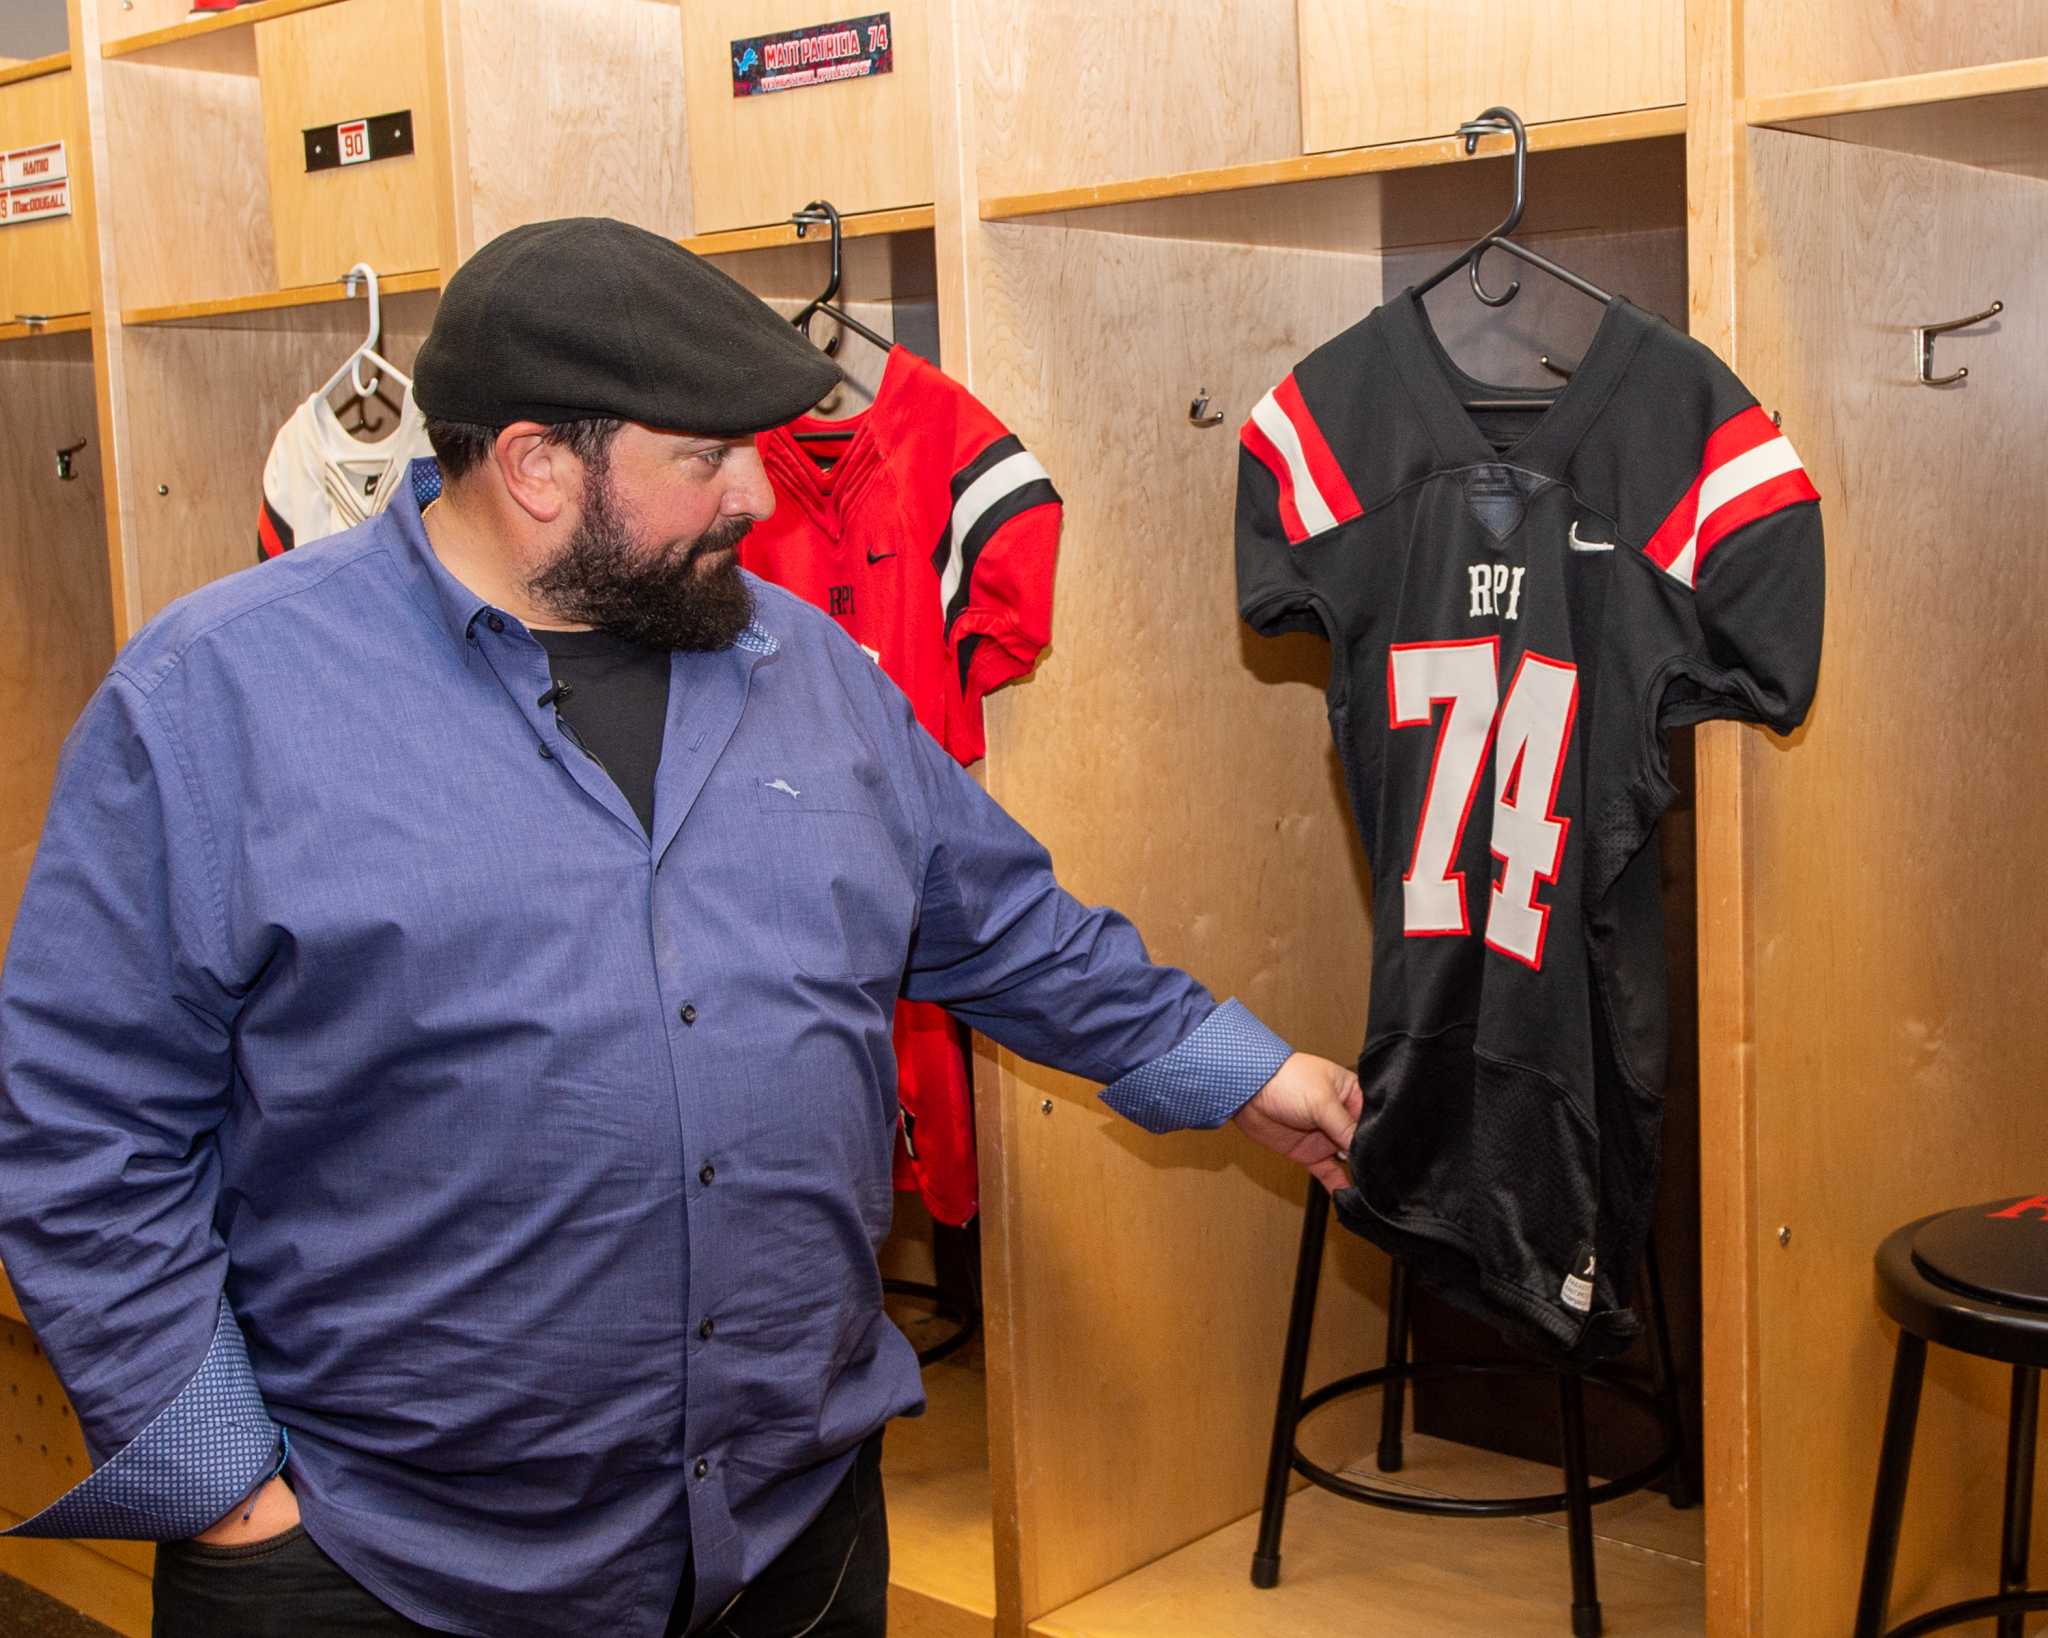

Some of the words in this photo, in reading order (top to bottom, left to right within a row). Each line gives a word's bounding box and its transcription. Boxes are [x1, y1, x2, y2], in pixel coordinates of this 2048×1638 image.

[764, 40, 800, 70] MATT
[800, 29, 861, 64] PATRICIA
[867, 24, 889, 53] 74
[344, 132, 364, 158] 90
[12, 192, 66, 215] MacDOUGALL
[828, 584, 856, 617] RPI
[1468, 564, 1526, 621] RPI
[1387, 635, 1580, 970] 74
